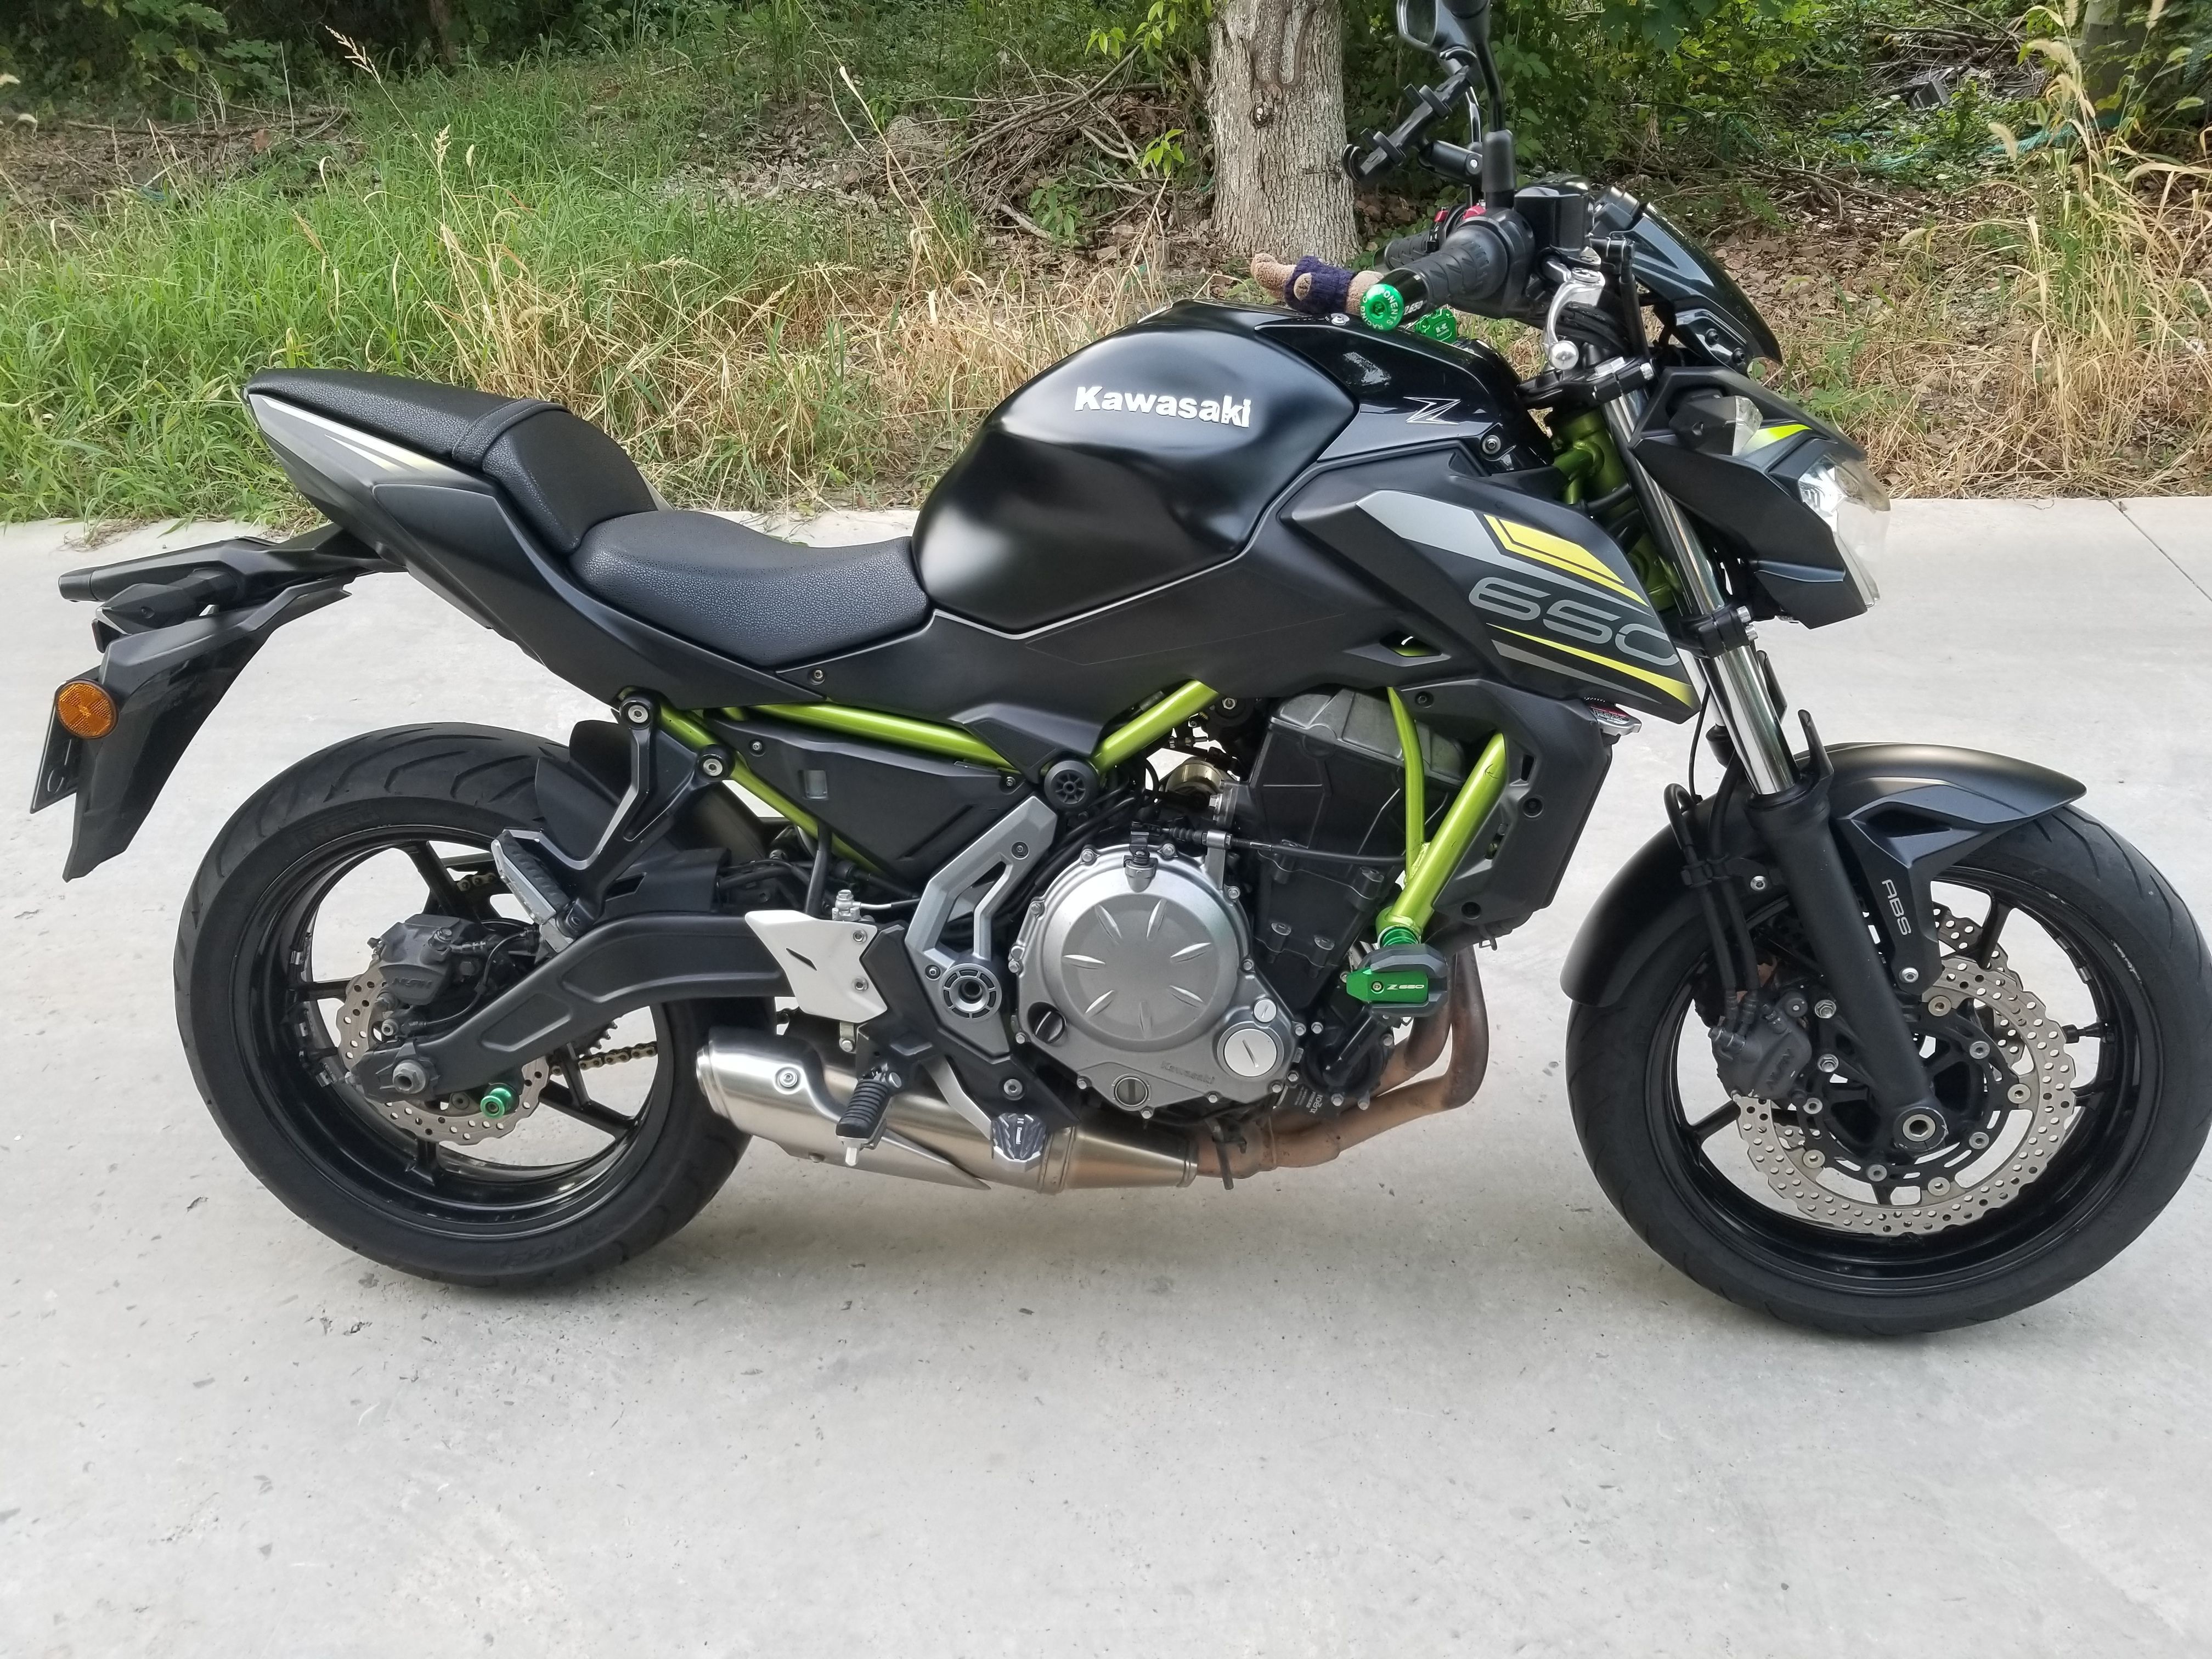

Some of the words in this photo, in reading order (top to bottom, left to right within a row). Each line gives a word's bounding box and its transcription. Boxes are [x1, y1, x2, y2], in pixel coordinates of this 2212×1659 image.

[1074, 386, 1251, 428] Kawasaki
[1468, 577, 1679, 666] 650
[1882, 879, 1912, 935] ABS
